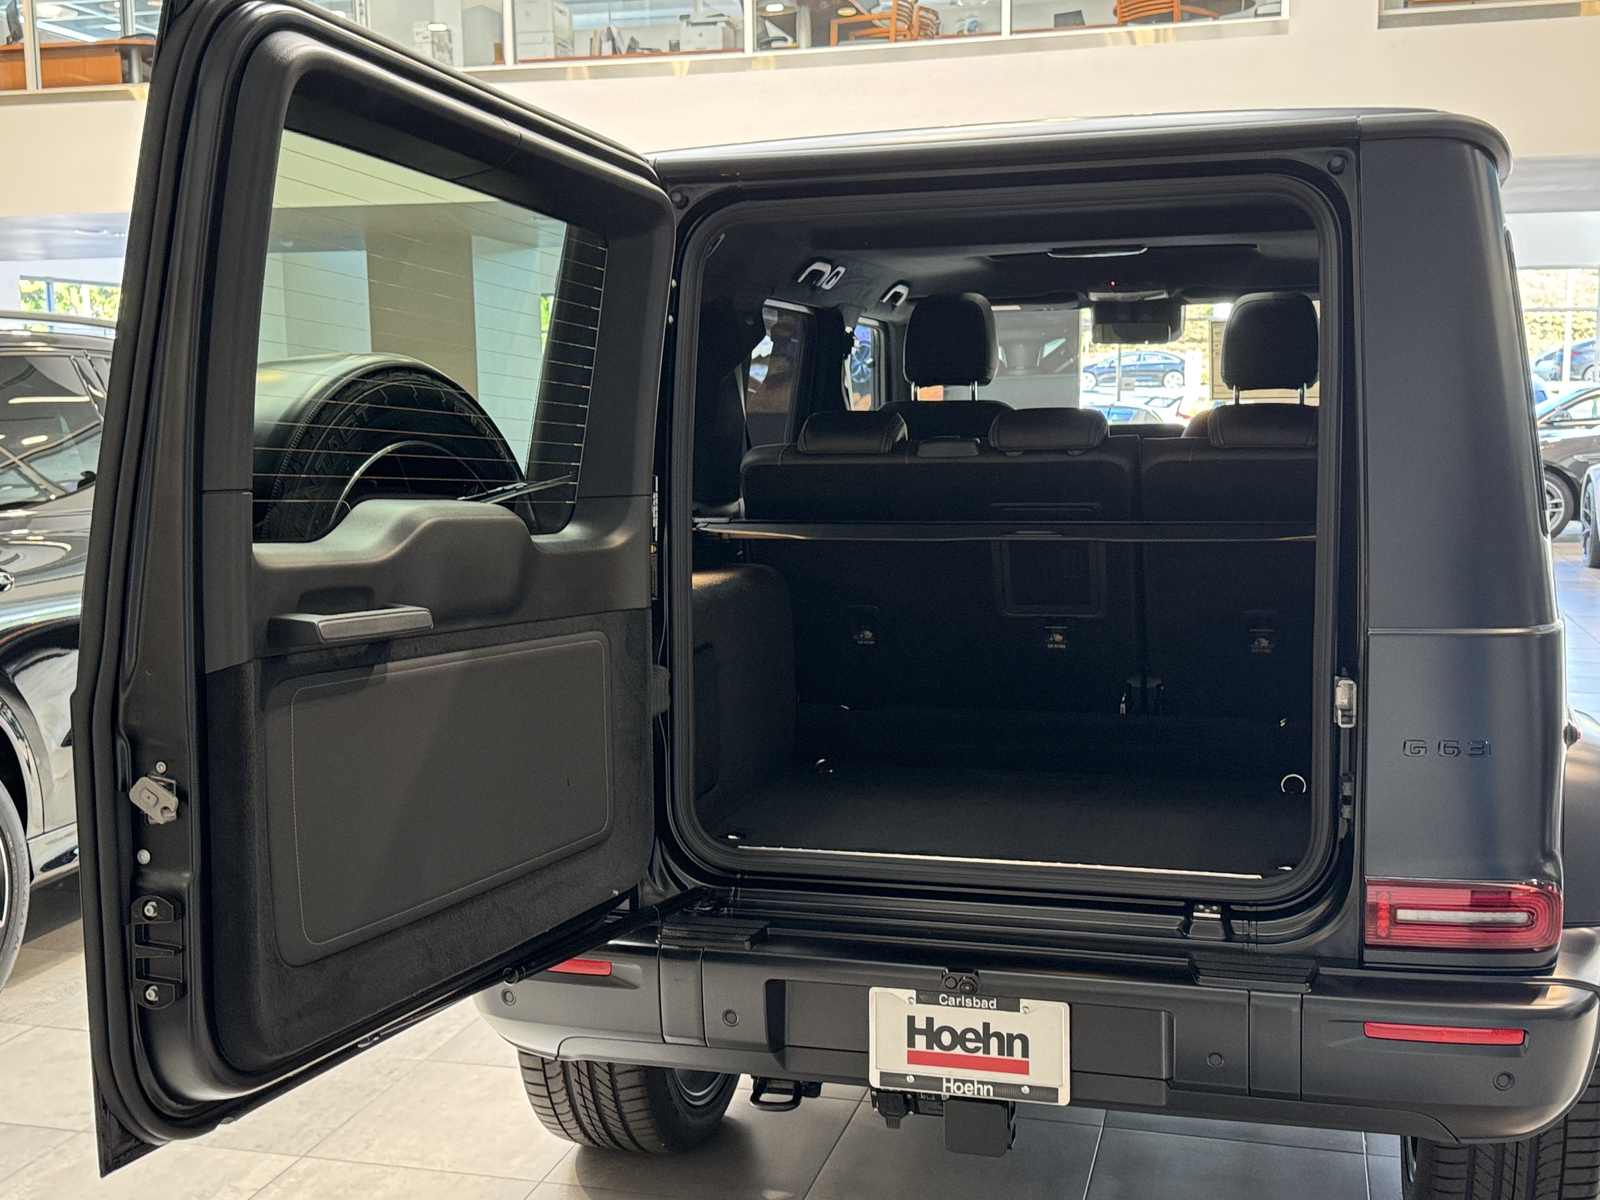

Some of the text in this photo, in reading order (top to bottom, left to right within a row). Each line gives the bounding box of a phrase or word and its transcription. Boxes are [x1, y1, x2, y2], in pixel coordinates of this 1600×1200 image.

[1403, 739, 1492, 758] G 63
[938, 993, 997, 1010] Carlsbad
[907, 1015, 1030, 1059] Hoehn
[942, 1077, 994, 1097] Hoehn
